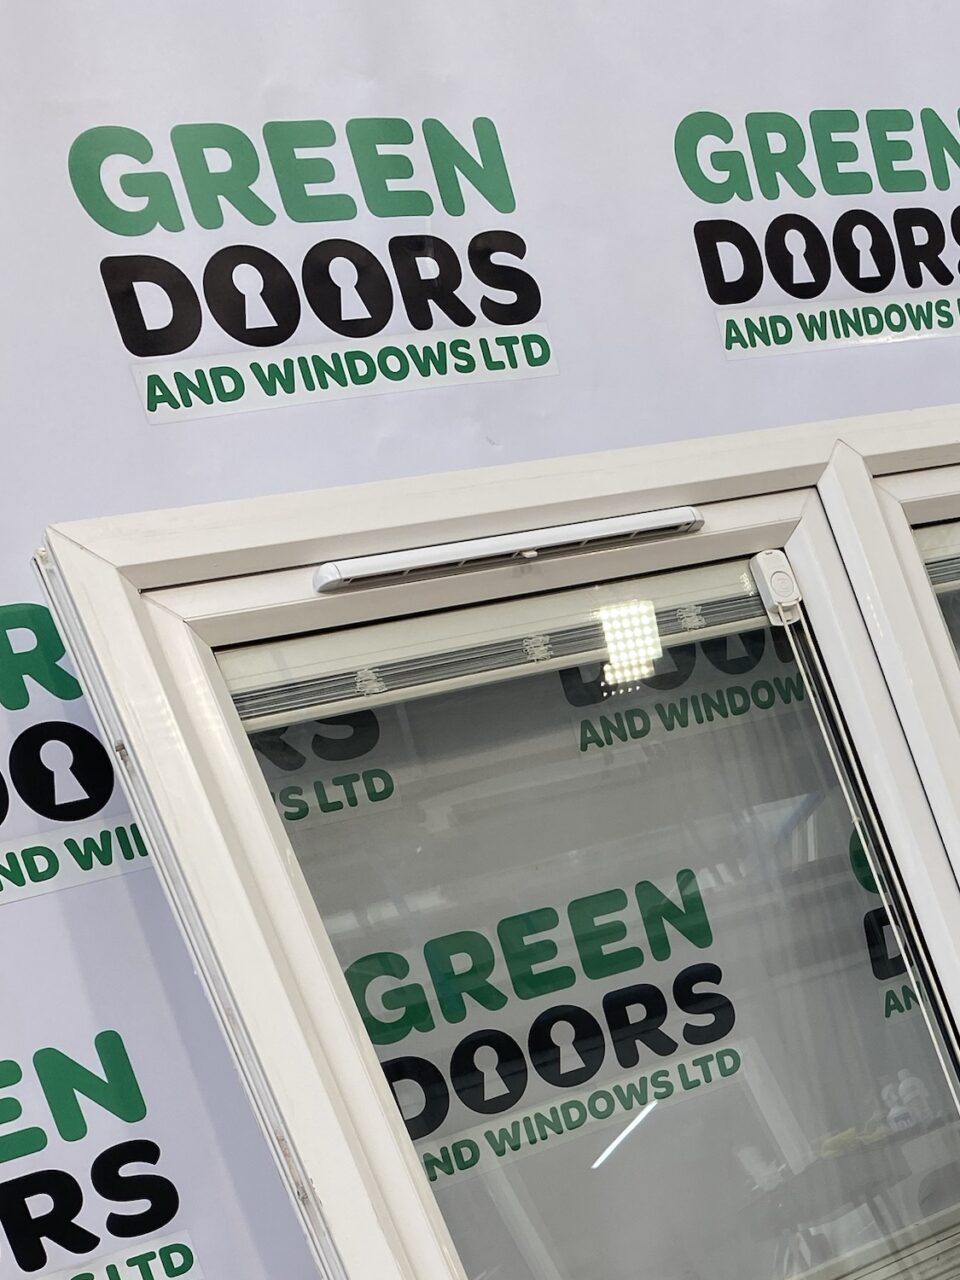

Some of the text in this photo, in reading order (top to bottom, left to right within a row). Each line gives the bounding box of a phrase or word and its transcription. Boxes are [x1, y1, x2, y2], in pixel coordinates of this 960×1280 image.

[68, 116, 516, 237] GREEN
[100, 230, 542, 357] DOORS
[725, 315, 793, 350] AND
[796, 299, 954, 342] WINDOWS
[146, 333, 551, 412] AND WINDOWS LTD
[580, 708, 650, 752] AND
[313, 768, 394, 813] LTD
[343, 868, 714, 1046] GREEN
[380, 962, 736, 1141] DOORS
[484, 1069, 674, 1158] WINDOWS
[677, 1047, 741, 1091] LTD
